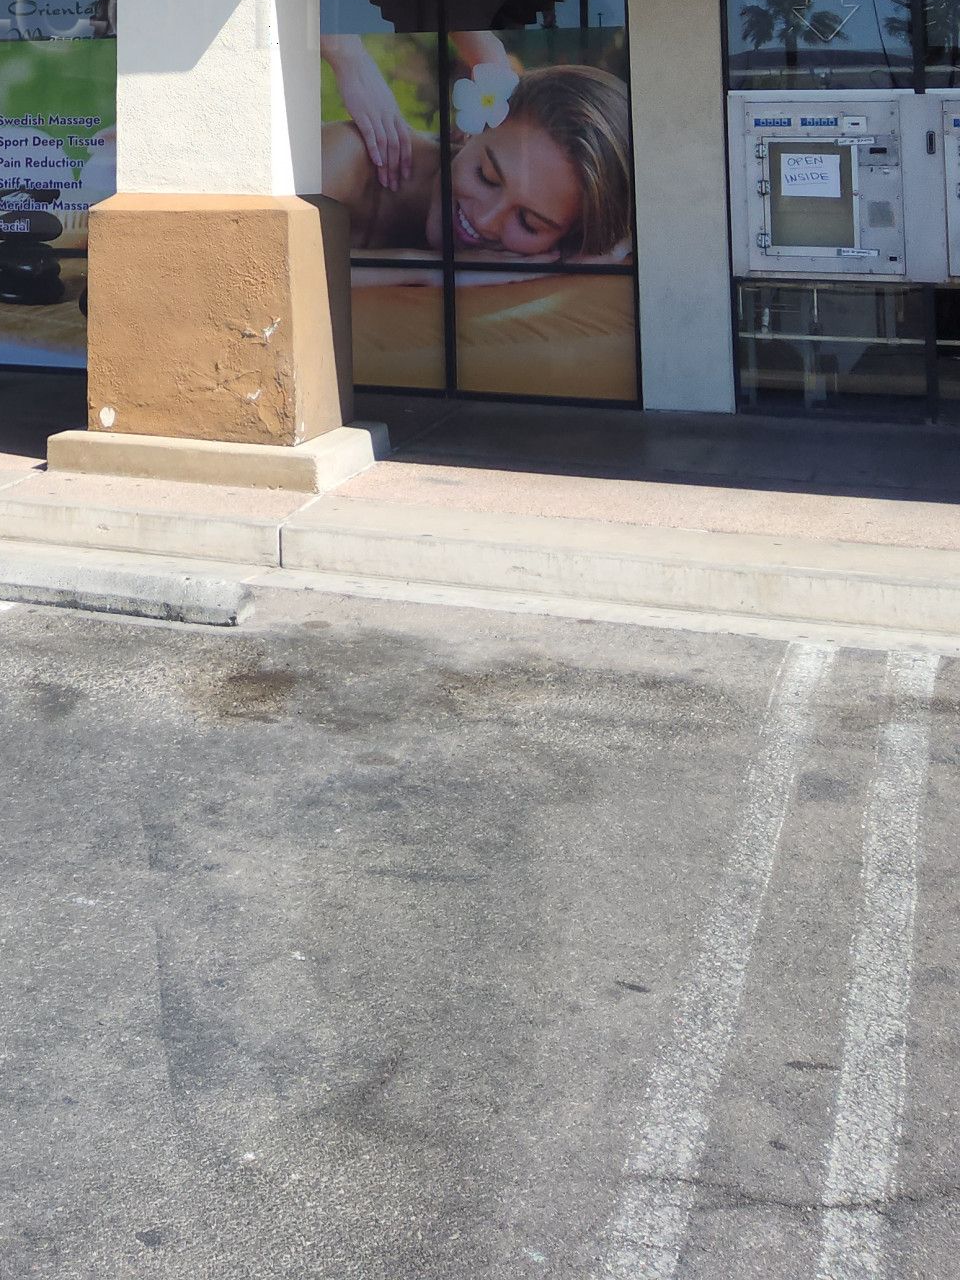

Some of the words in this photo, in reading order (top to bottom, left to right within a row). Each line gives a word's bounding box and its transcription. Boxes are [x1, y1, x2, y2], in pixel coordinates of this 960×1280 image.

[49, 114, 101, 128] Massage
[32, 136, 64, 150] Deep
[67, 135, 105, 146] Tissue
[25, 156, 84, 168] Reduction
[786, 156, 824, 167] OPEN
[784, 171, 830, 184] INSIDE
[23, 178, 83, 190] Treatment
[52, 199, 90, 211] Massa
